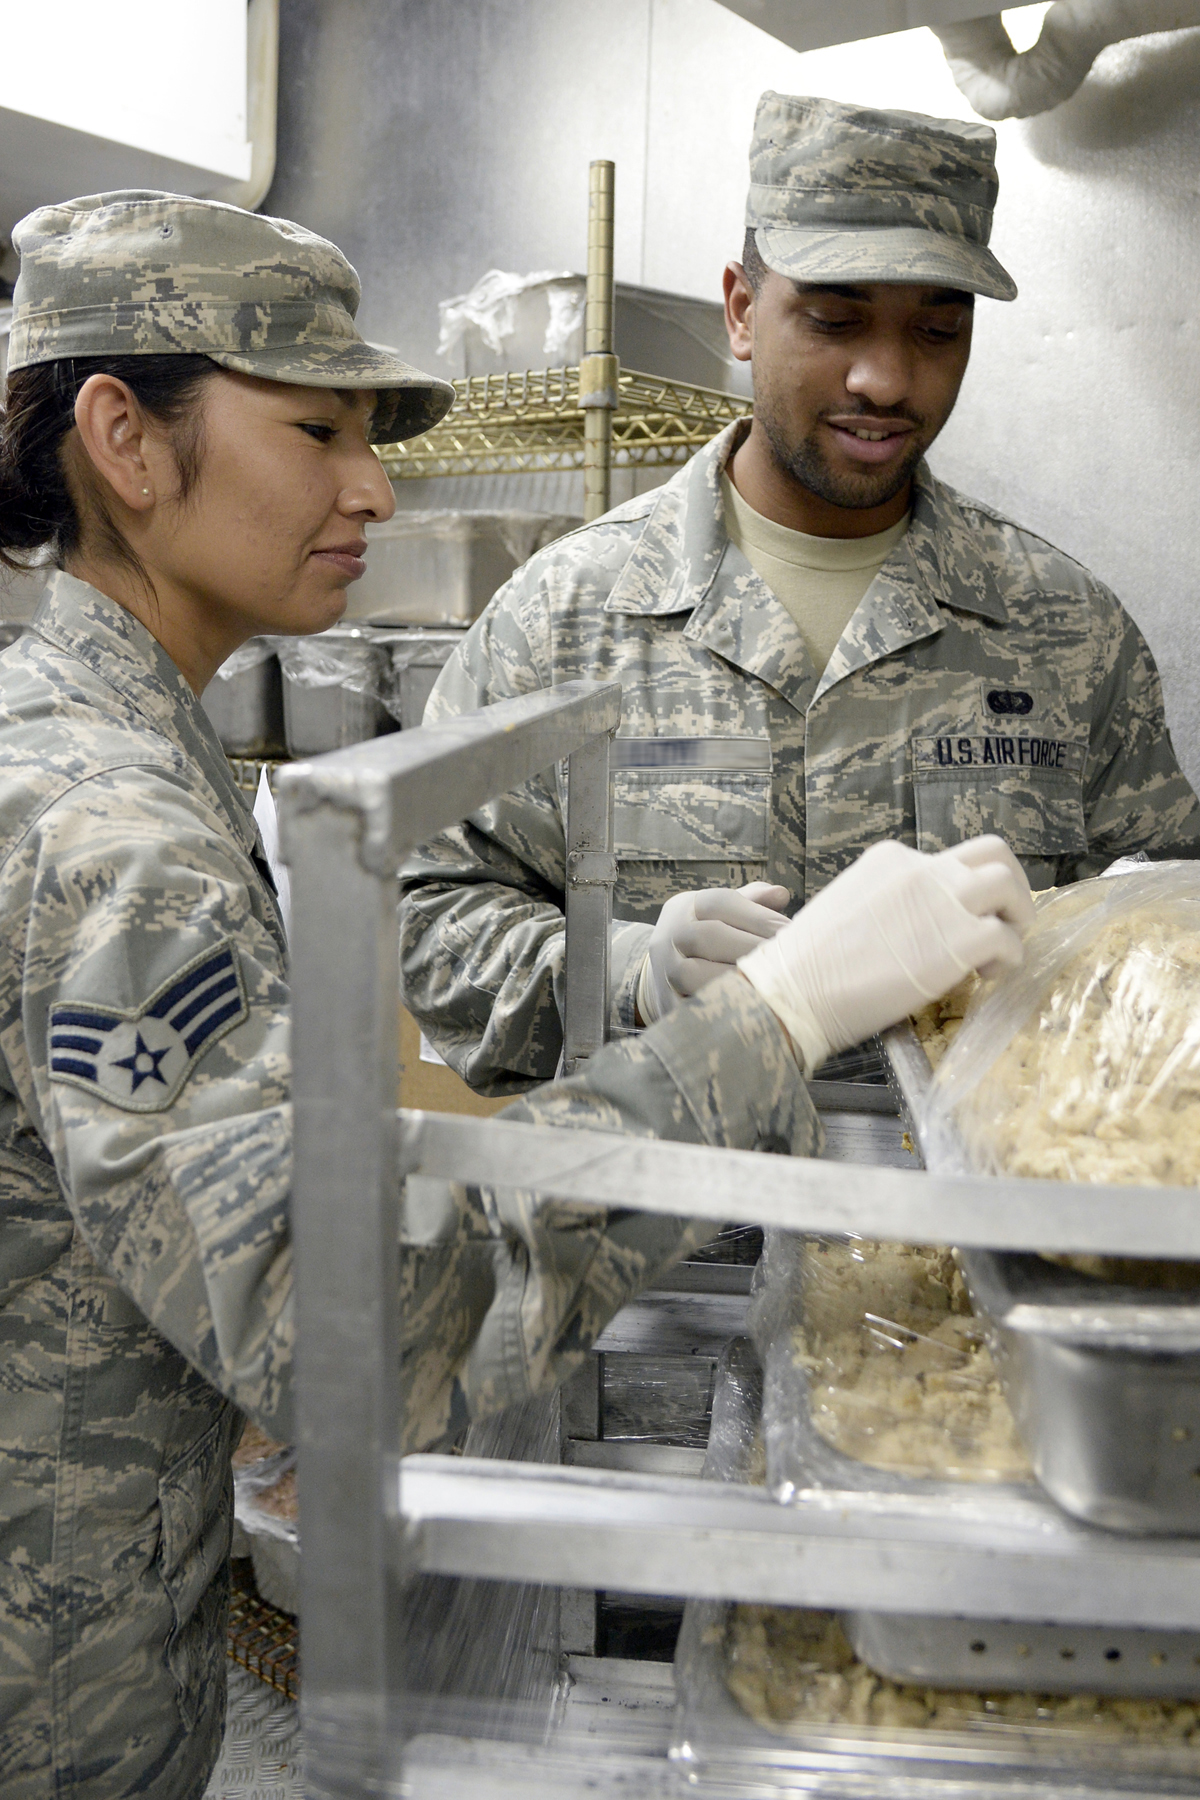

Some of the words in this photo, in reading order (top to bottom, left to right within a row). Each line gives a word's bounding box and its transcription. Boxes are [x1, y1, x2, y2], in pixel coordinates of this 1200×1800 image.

[937, 738, 978, 766] U.S.
[983, 738, 1015, 765] AIR
[1018, 738, 1067, 768] FORCE
